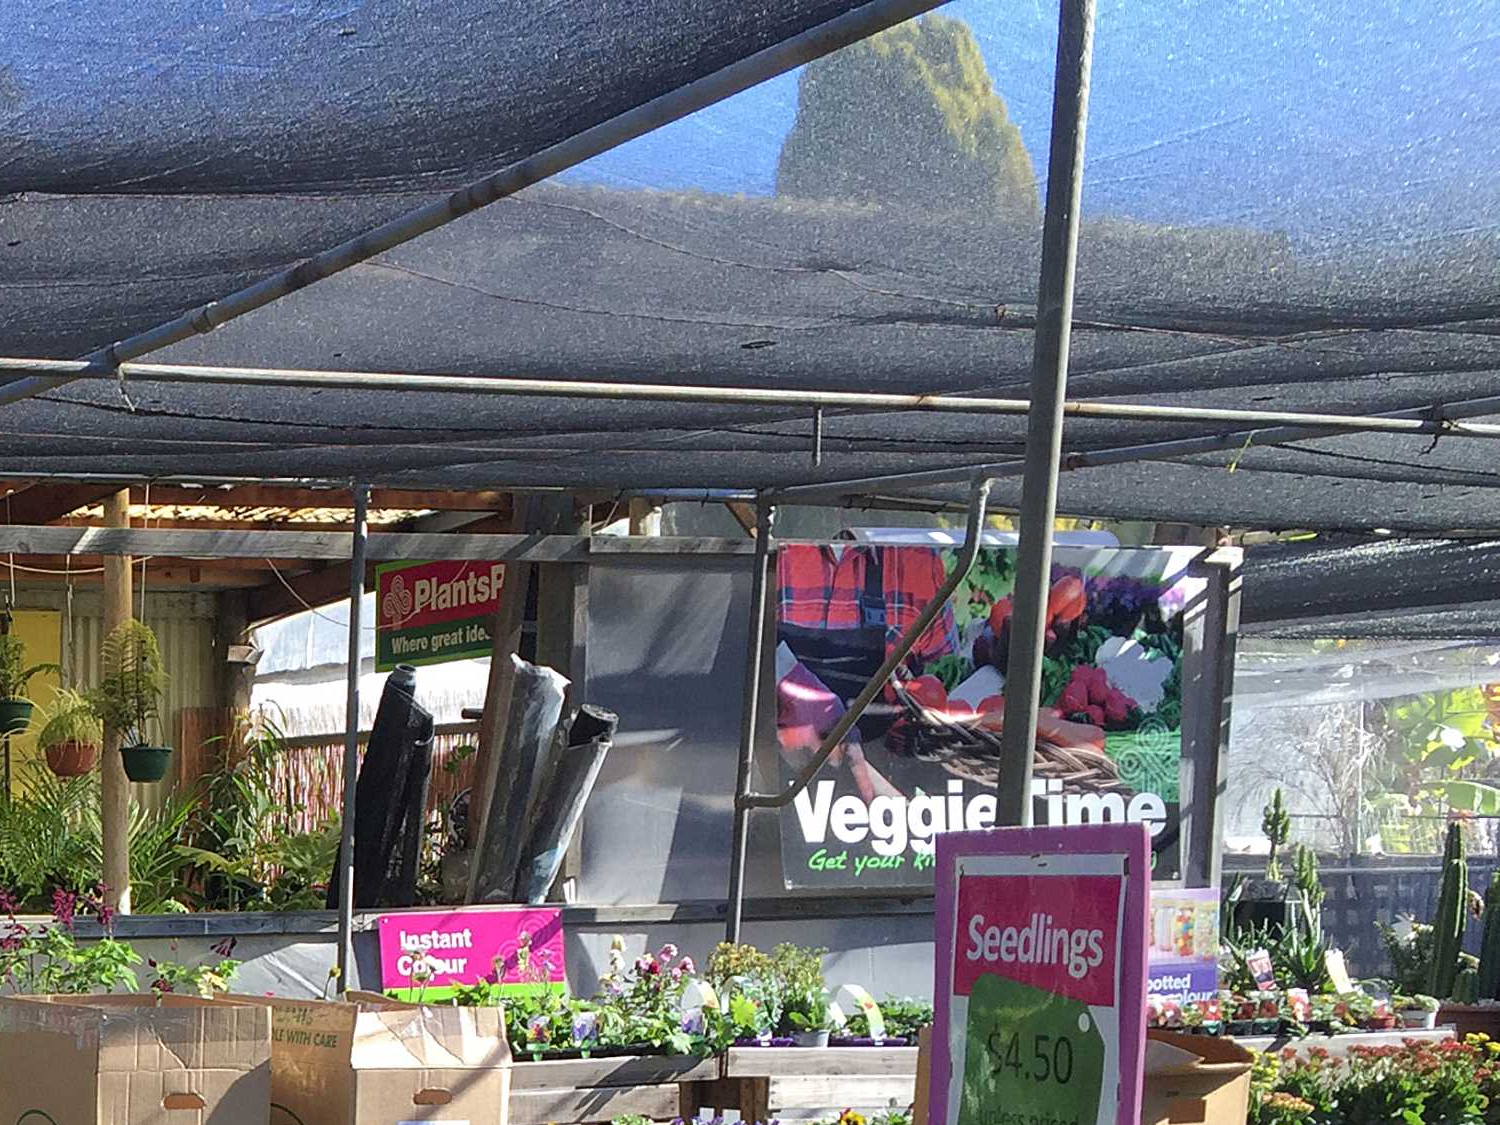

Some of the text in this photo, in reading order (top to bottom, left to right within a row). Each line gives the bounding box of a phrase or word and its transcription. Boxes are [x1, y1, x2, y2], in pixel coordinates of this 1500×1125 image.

[414, 564, 505, 611] PlantsP
[392, 624, 491, 655] Where great ide
[790, 779, 997, 856] Veggie
[808, 848, 849, 870] Get
[854, 852, 905, 877] your
[399, 928, 473, 950] Instant
[966, 913, 1104, 979] Seedlings
[987, 1022, 1074, 1085] $4.50
